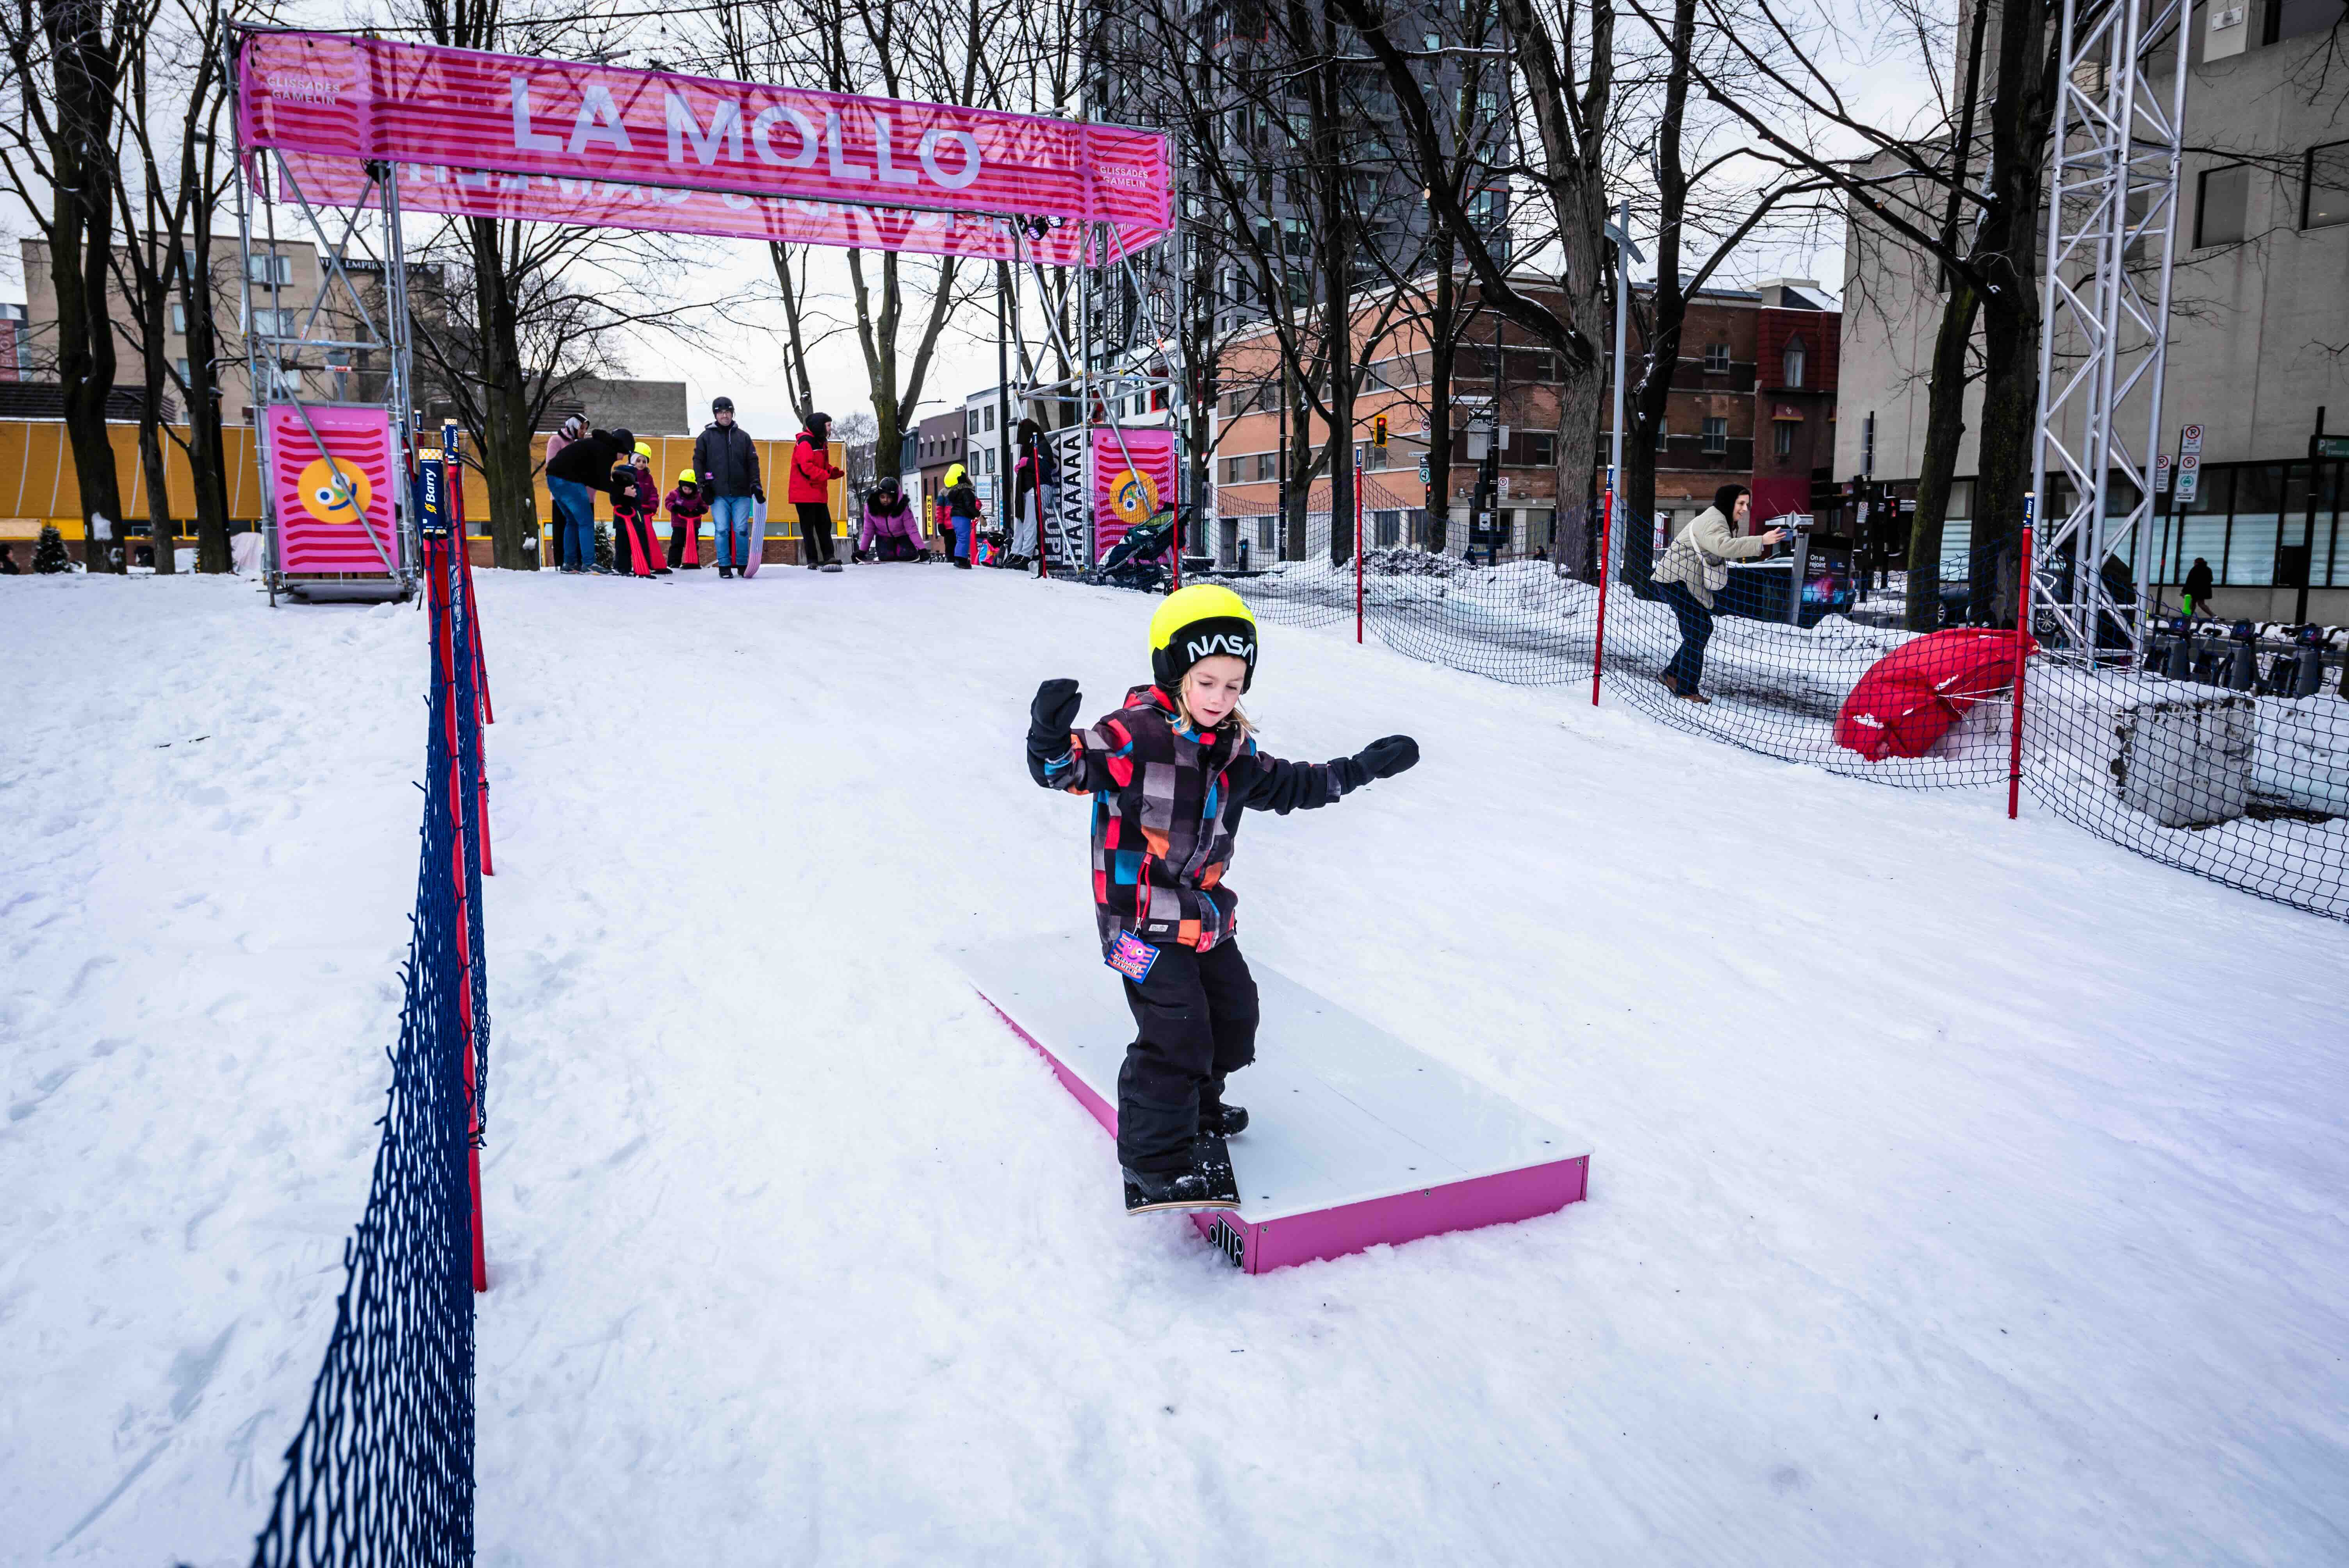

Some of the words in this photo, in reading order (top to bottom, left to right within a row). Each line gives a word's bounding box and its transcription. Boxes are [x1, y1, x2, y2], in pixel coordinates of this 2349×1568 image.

[267, 76, 340, 94] GLISSADES
[272, 89, 336, 106] GAMELIN
[510, 76, 634, 154] LA
[665, 93, 981, 190] MOLLO
[1100, 166, 1149, 179] GLISSADES
[1103, 176, 1146, 188] GAMELIN
[425, 468, 437, 503] Barry
[1187, 634, 1254, 666] NASA
[1112, 960, 1137, 975] GAMELIN
[1114, 953, 1143, 971] GLISSADES
